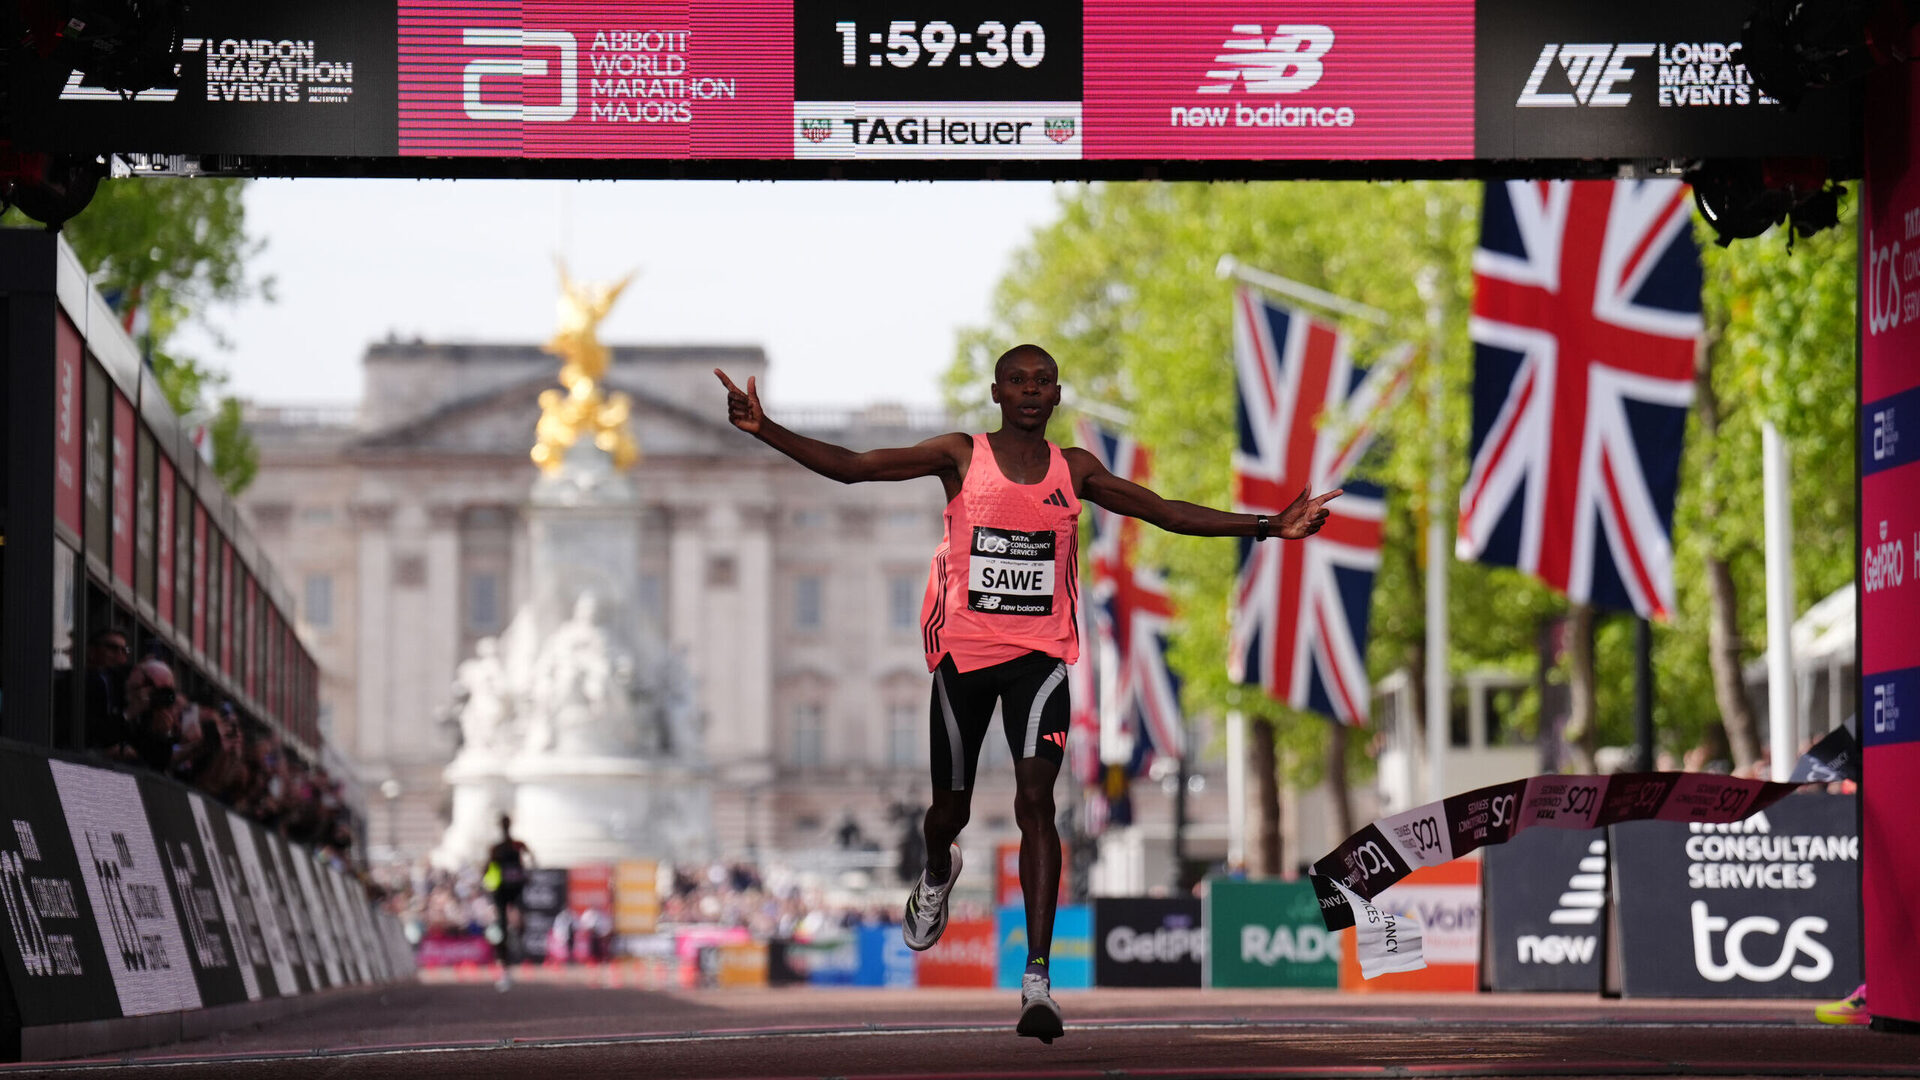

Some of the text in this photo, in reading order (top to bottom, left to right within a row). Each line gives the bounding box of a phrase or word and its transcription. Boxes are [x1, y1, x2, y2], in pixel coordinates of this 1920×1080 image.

[207, 39, 314, 61] LONDON
[590, 30, 691, 52] ABBOTT
[835, 21, 1046, 68] 1:59:30
[207, 60, 353, 82] MARATHON
[590, 54, 686, 76] WORLD
[1659, 63, 1754, 85] MARAT
[207, 82, 299, 102] EVENTS
[590, 77, 735, 100] MARATHON
[1659, 85, 1751, 107] EVENTS
[590, 100, 692, 122] MAJORS
[1170, 101, 1356, 127] new balance
[1869, 229, 1900, 336] tcs
[977, 531, 1008, 554] tcs
[1010, 542, 1051, 550] CONSULTANCY
[1011, 535, 1030, 543] TATA
[1009, 549, 1038, 557] SERVICES
[1865, 539, 1904, 594] GetPRO
[981, 567, 1044, 591] SAWE
[1016, 603, 1045, 612] balance
[1562, 786, 1598, 821] tcs
[1412, 816, 1443, 854] tcs
[1352, 840, 1396, 881] tcs
[1688, 863, 1817, 889] SERVICES
[1516, 935, 1598, 965] new
[1690, 900, 1834, 982] tcs
